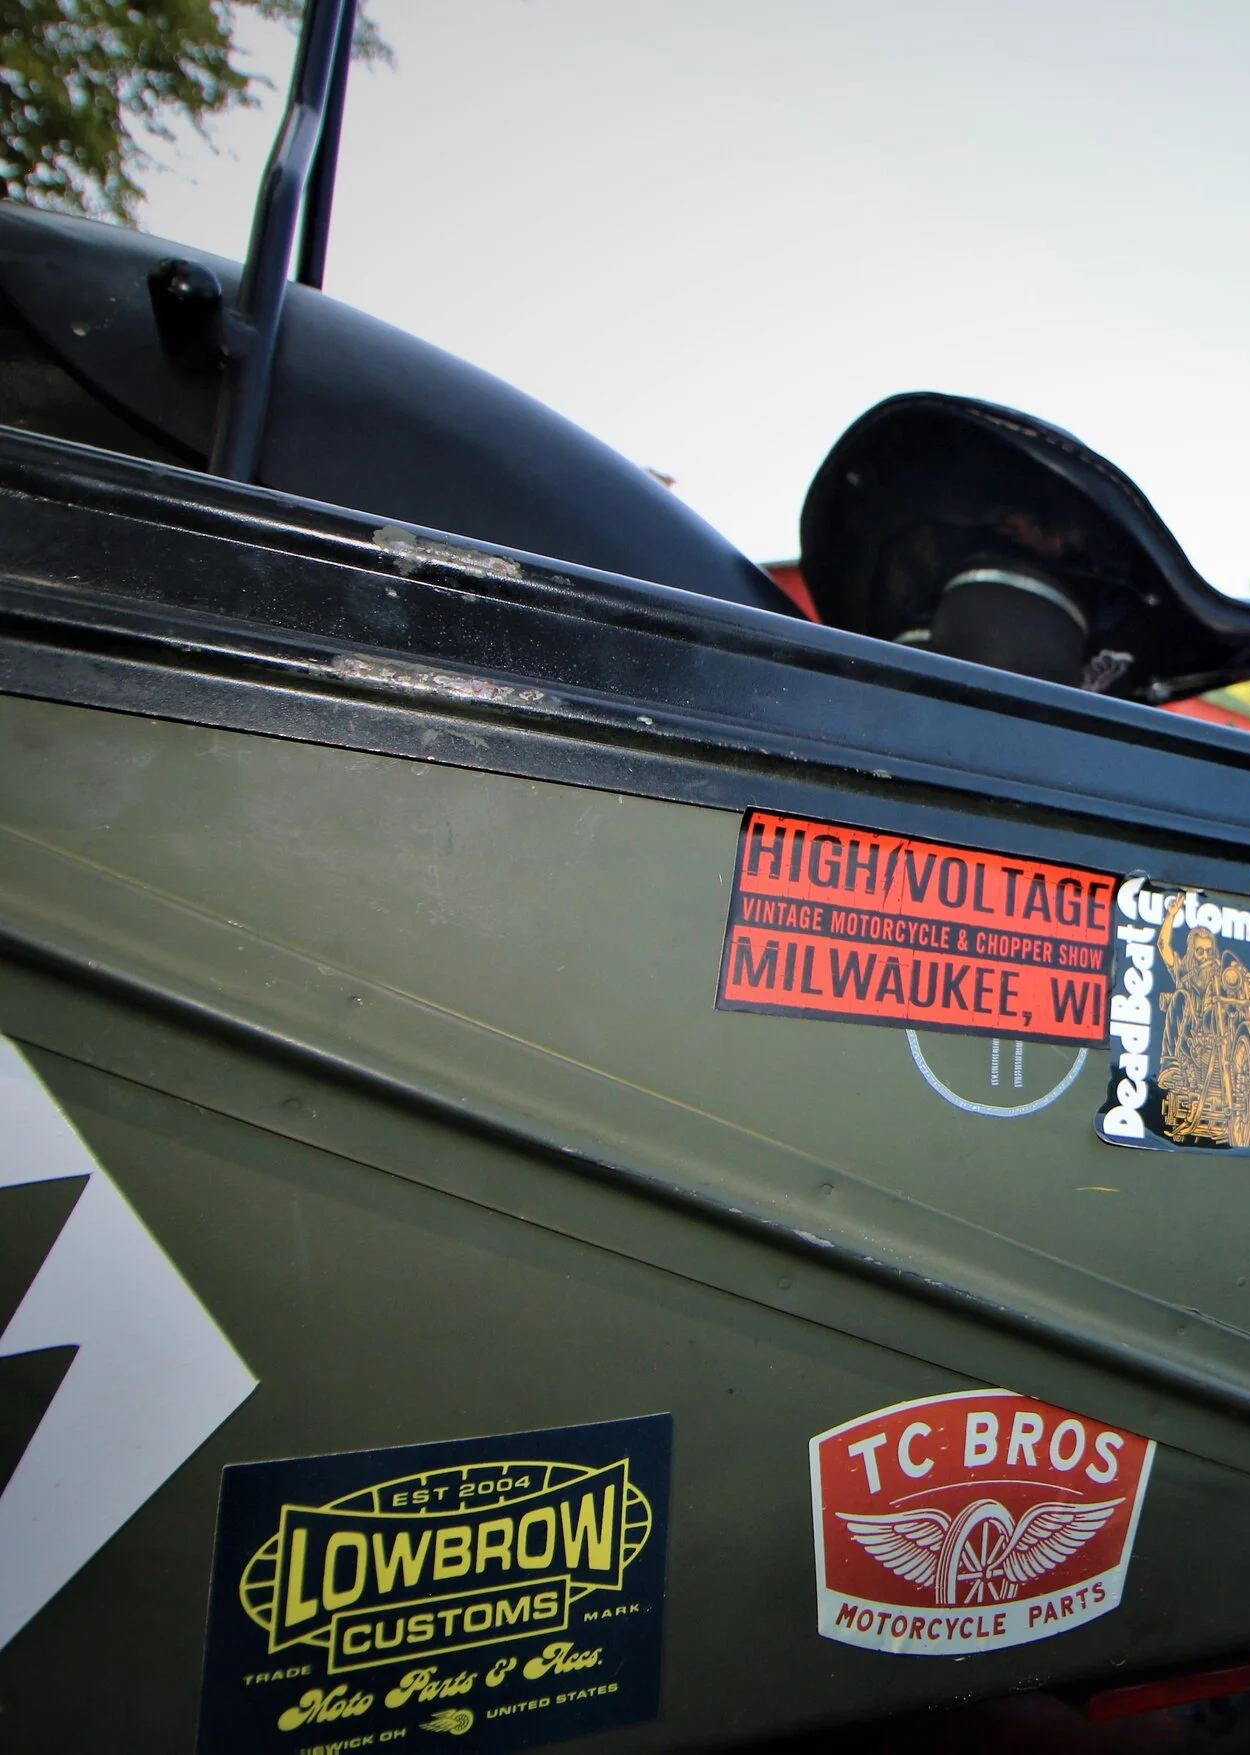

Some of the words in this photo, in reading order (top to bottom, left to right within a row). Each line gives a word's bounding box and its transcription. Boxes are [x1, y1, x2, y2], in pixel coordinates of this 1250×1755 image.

[747, 822, 880, 895] HIGH
[904, 849, 1110, 931] VOLTAGE
[742, 897, 823, 932] VINTAGE
[831, 910, 949, 949] MOTORCYCLE
[956, 931, 969, 952] &
[976, 933, 1053, 964] CHOPPER
[1058, 944, 1103, 971] SHOW
[732, 936, 1033, 1026] MILWAUKEE,
[1051, 976, 1101, 1026] WI
[848, 1422, 935, 1494] TC
[963, 1411, 1125, 1484] BROS
[392, 1487, 445, 1507] EST
[458, 1475, 532, 1498] 2004
[285, 1484, 614, 1627] LOWBROW
[342, 1591, 559, 1655] CUSTOMS
[584, 1603, 640, 1622] MARK
[835, 1602, 1006, 1641] MOTORCYCLE
[1028, 1582, 1107, 1628] PARTS
[243, 1664, 313, 1687] TRADE
[277, 1683, 375, 1732] Moto
[385, 1665, 478, 1709] Parts
[485, 1657, 518, 1688] &
[486, 1698, 551, 1720] UNITED
[556, 1683, 619, 1705] STATES
[379, 1728, 407, 1743] OH
